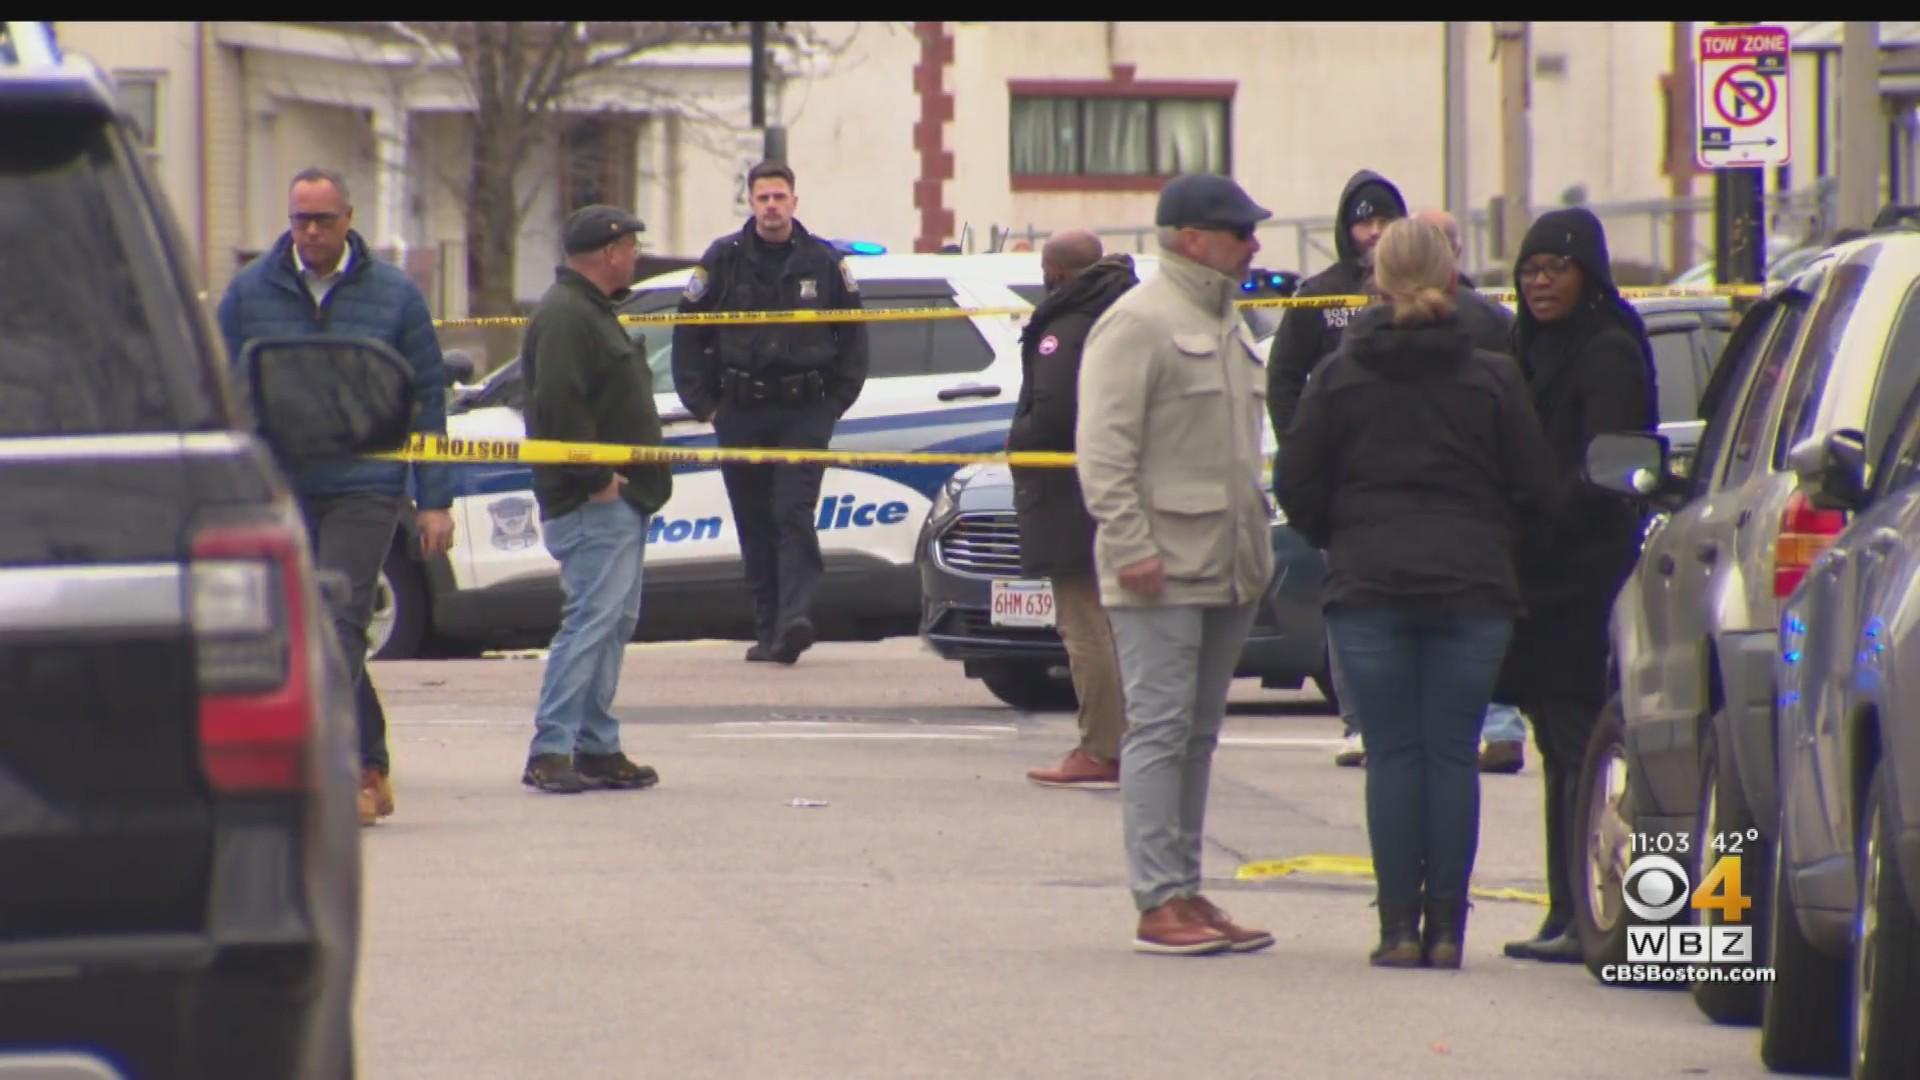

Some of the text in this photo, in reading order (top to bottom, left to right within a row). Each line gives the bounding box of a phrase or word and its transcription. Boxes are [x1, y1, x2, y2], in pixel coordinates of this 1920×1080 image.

[1703, 34, 1785, 54] TOW ZONE
[1323, 307, 1361, 319] BOST
[436, 436, 520, 461] BOSTON
[648, 494, 909, 544] ton lice
[994, 591, 1053, 616] 6HM 639
